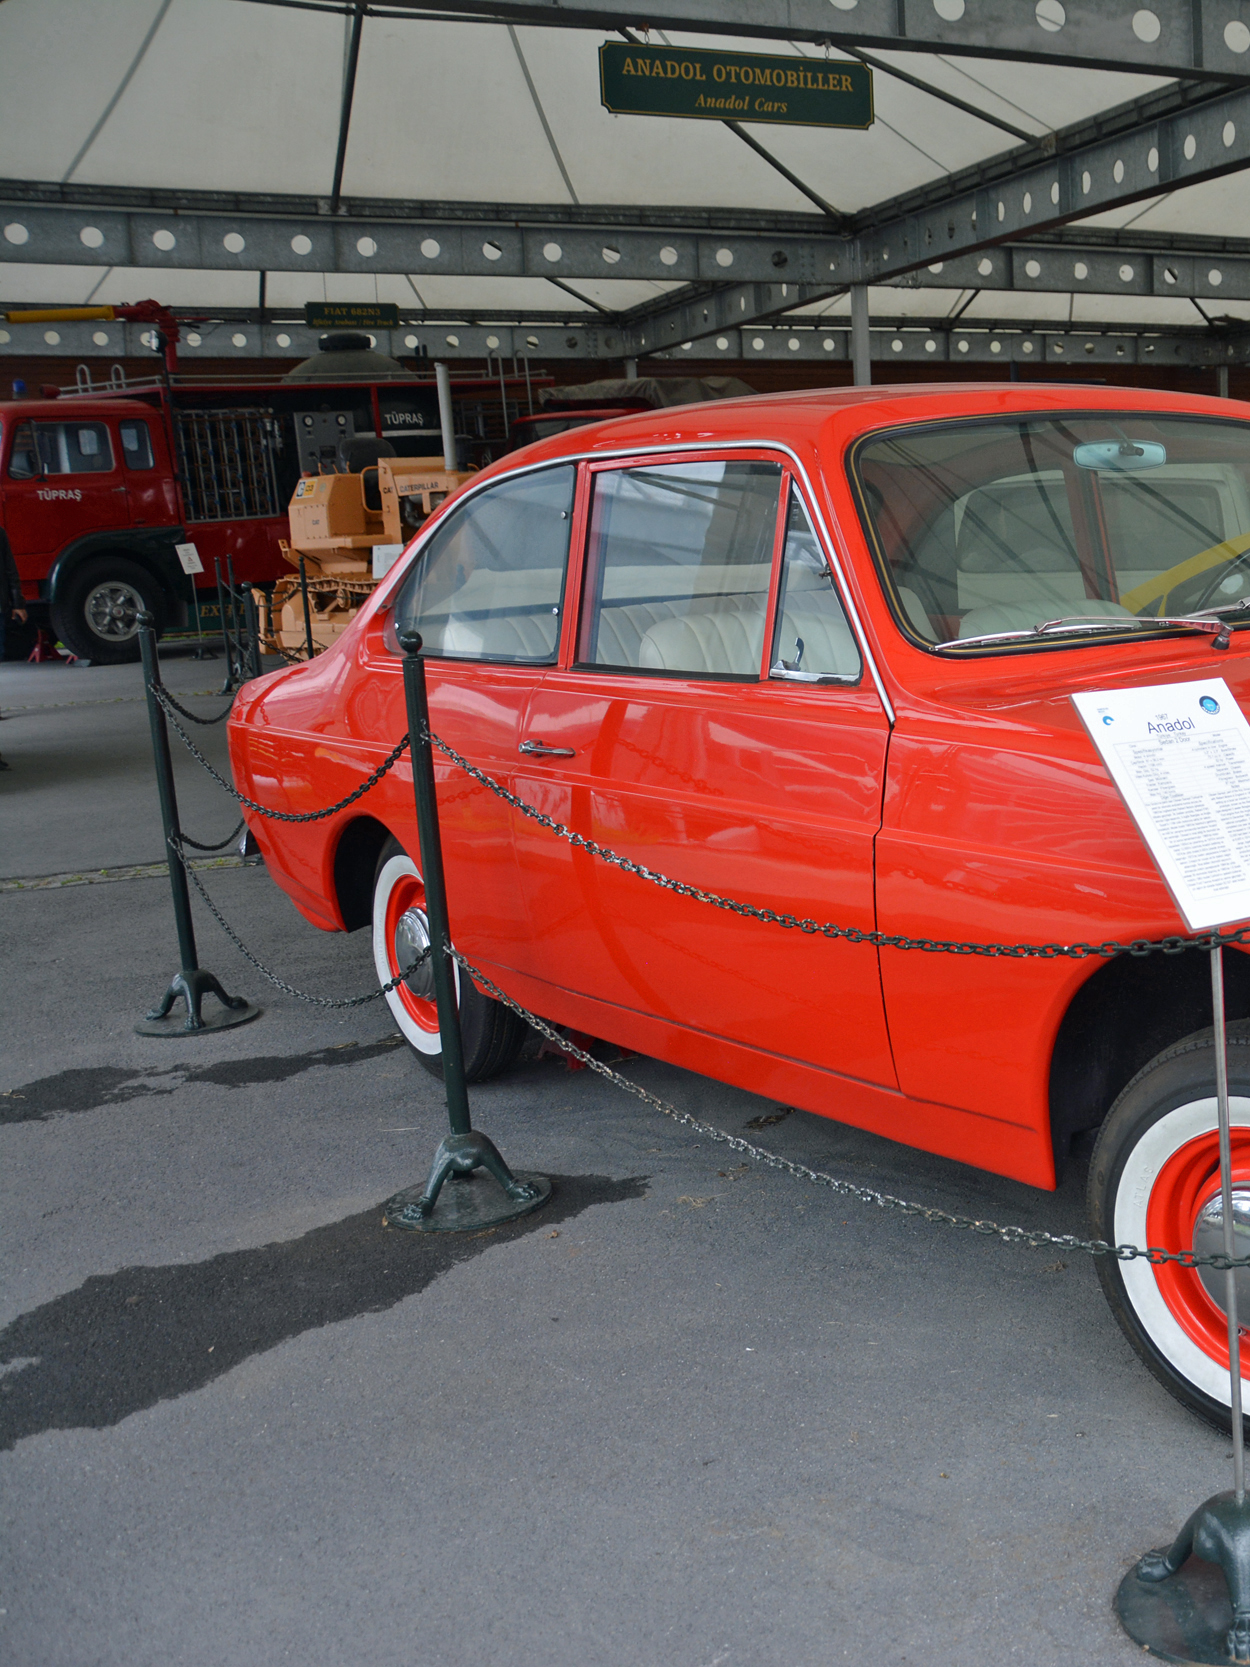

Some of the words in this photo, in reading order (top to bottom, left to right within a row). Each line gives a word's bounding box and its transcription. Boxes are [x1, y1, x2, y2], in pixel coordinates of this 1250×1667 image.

[622, 57, 706, 81] ANADOL
[712, 66, 854, 92] OTOMOBİLLER
[695, 94, 749, 110] Anadol
[754, 98, 788, 113] Cars
[324, 307, 348, 315] FIAT
[384, 410, 424, 426] TÜPRAŞ
[37, 488, 82, 502] TÜPRAŞ
[400, 482, 438, 492] CATERPILLAR
[1147, 717, 1196, 734] Anadol
